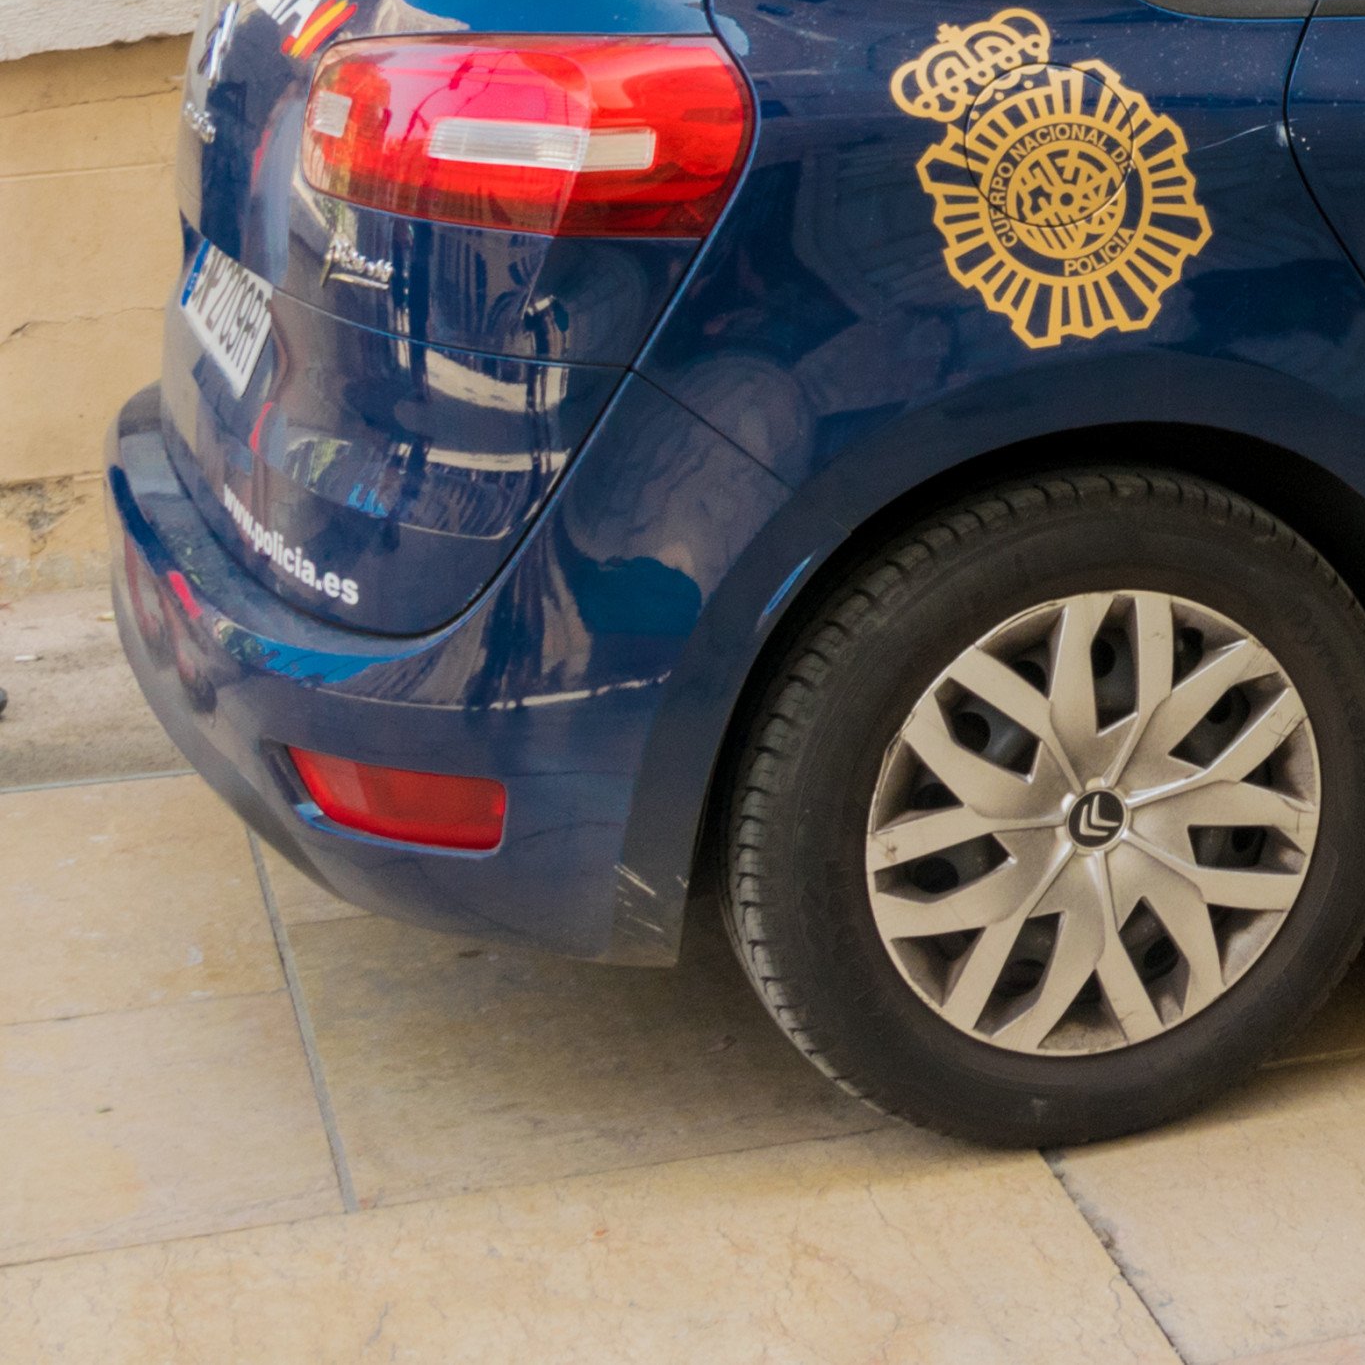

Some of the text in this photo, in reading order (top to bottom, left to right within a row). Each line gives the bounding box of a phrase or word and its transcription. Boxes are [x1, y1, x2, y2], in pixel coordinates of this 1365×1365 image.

[989, 123, 1137, 248] CUERPO NACIONAL DE
[1064, 227, 1137, 278] POLICIA
[224, 483, 359, 605] www.policia.es
